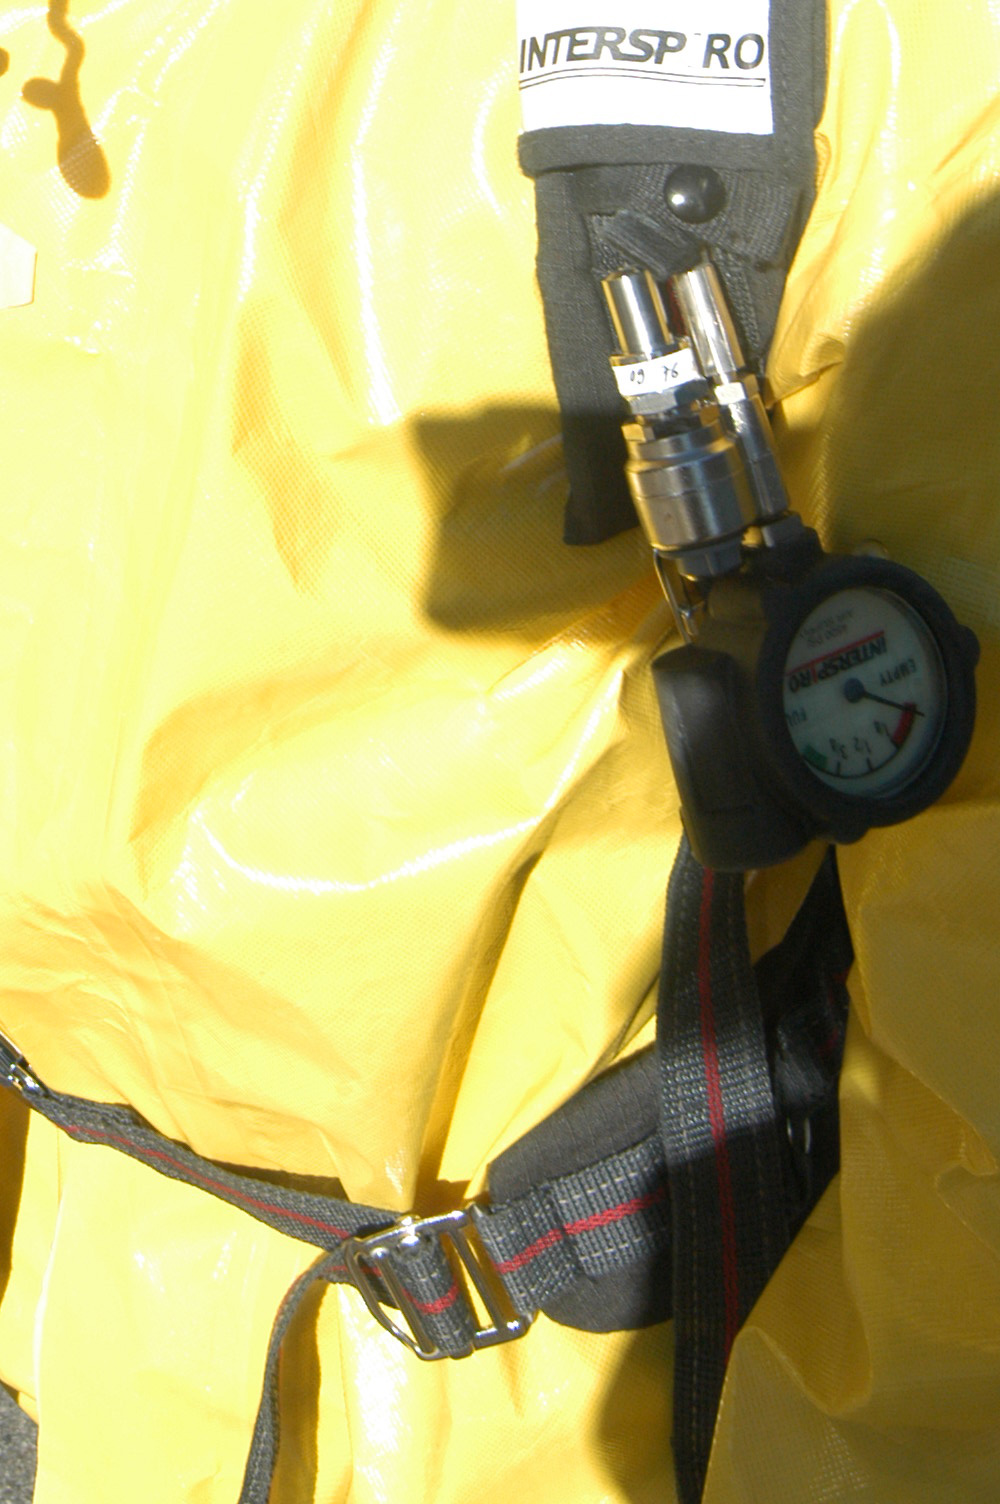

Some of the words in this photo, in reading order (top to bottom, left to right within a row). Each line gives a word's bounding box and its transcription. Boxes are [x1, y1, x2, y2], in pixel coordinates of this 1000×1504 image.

[519, 25, 765, 74] INTERSPRO
[788, 636, 888, 694] INTERSPIRO
[880, 657, 917, 687] EMPTY
